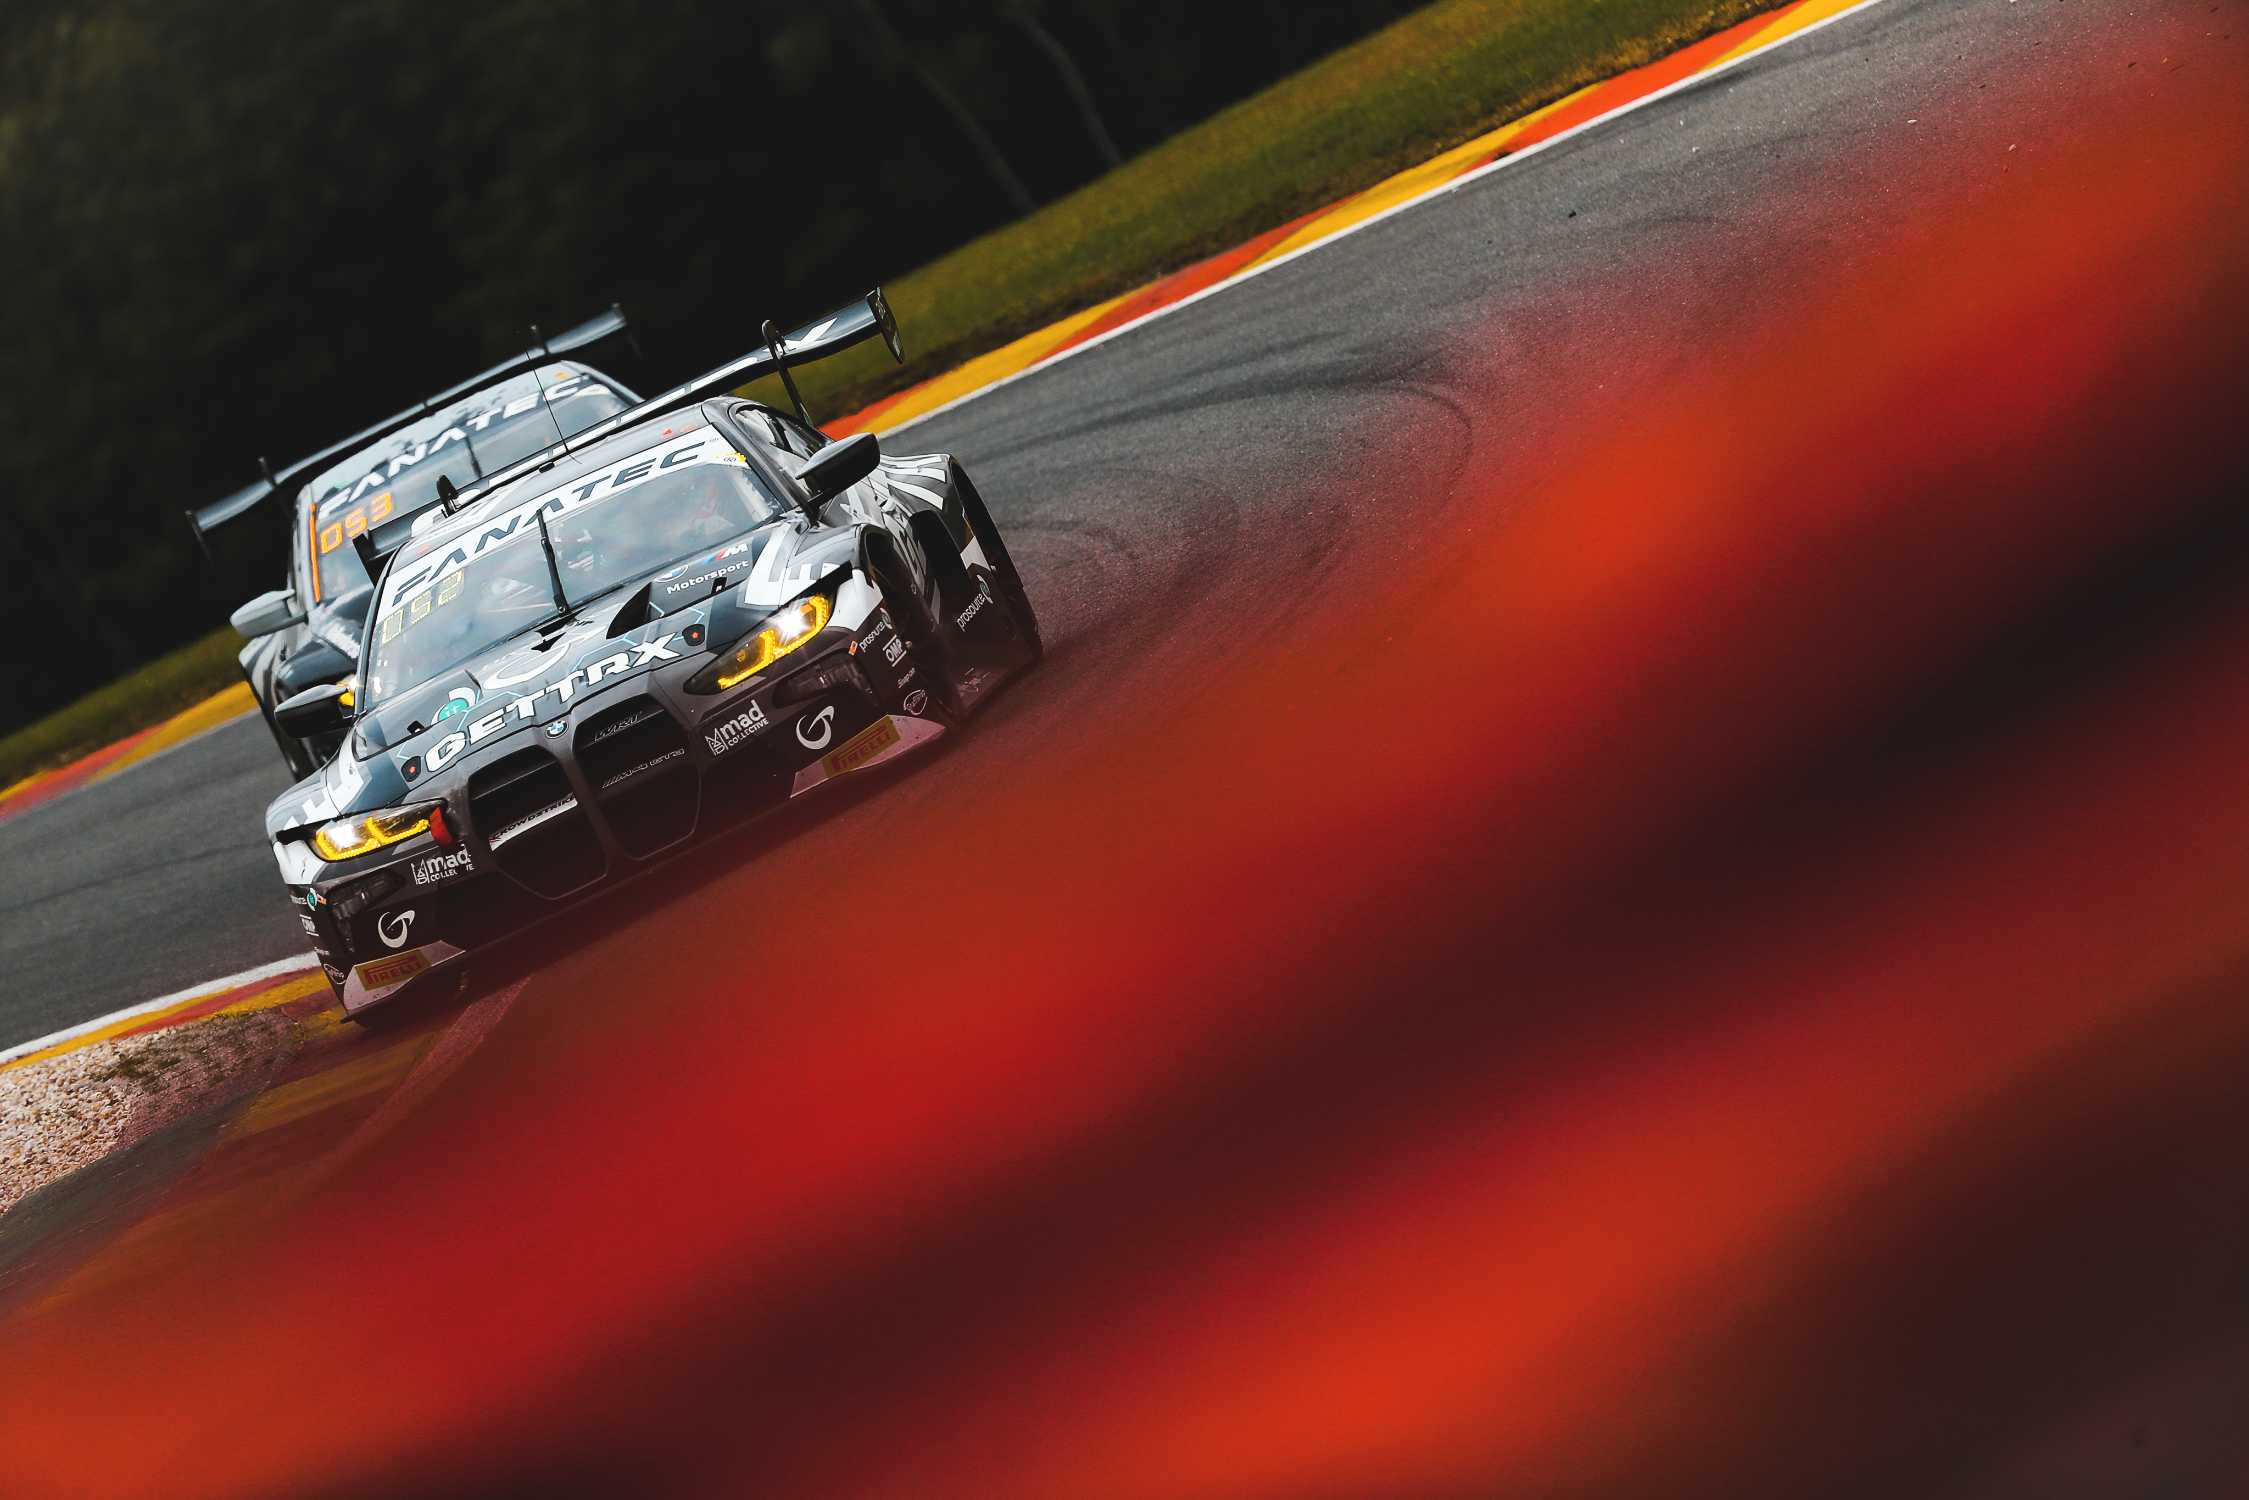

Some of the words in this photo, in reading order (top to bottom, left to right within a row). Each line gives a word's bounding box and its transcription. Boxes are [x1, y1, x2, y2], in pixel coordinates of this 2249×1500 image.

[318, 373, 587, 520] FANATEC
[320, 491, 392, 554] 053
[391, 441, 706, 607] FANATEC
[666, 560, 749, 595] Motorsport
[957, 594, 986, 632] prosource
[859, 621, 886, 653] prosource
[885, 638, 903, 663] OMP
[425, 632, 682, 773] GETTRX
[720, 699, 764, 740] mad
[728, 718, 769, 747] COLLECTIVE
[426, 843, 471, 874] mad
